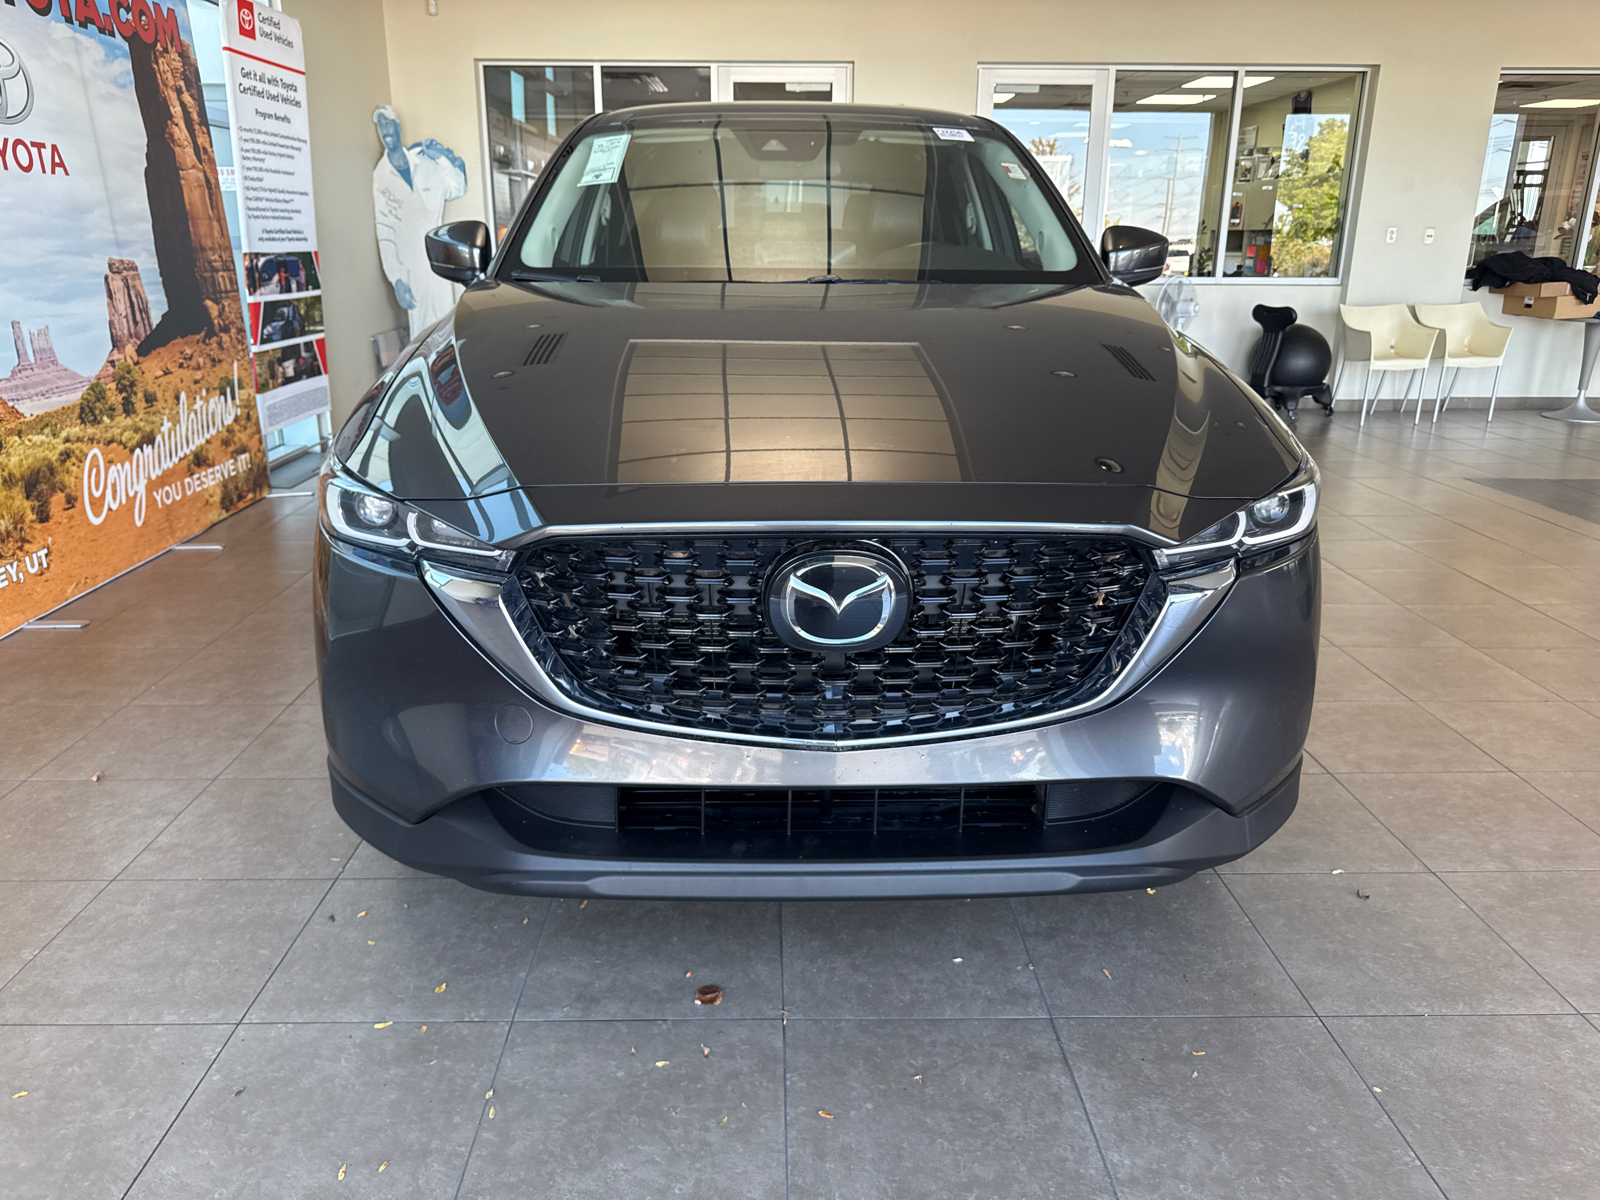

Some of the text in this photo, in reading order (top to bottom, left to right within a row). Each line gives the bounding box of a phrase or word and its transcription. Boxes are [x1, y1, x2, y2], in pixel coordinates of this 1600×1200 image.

[257, 12, 281, 30] Certified
[258, 26, 294, 49] Used Vehicles
[240, 67, 298, 93] Get it all with Toyota
[238, 82, 302, 108] Certified Used Vehicles
[255, 108, 291, 124] Program Benefits
[83, 360, 241, 527] Congratulations!
[153, 452, 252, 508] YOU DESERVE IT!
[24, 547, 49, 575] UT
